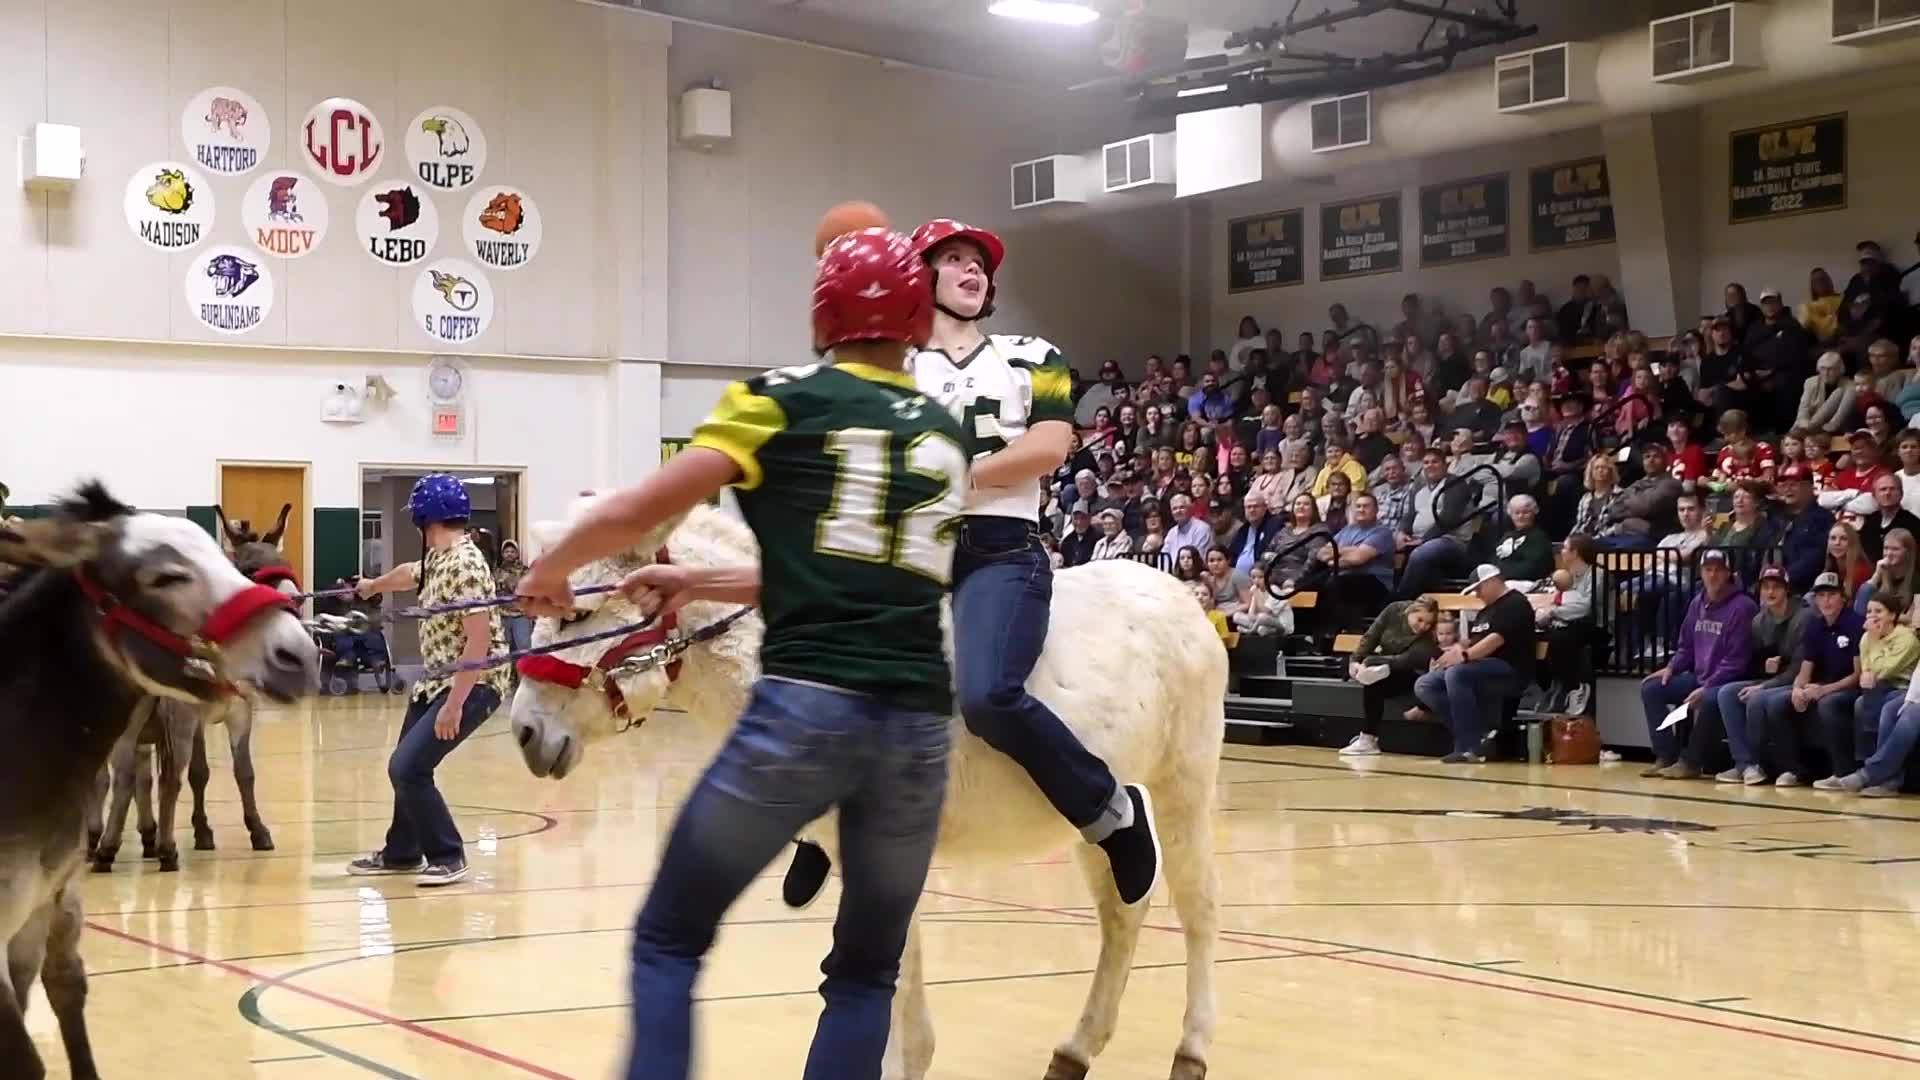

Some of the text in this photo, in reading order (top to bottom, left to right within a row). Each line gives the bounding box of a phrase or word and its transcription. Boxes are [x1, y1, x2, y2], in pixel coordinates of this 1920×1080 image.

[306, 109, 380, 175] LCL
[196, 144, 257, 172] HARTFORD
[419, 162, 474, 188] OLPE
[1769, 192, 1804, 211] 2022
[140, 220, 201, 248] MADISON
[257, 227, 315, 254] MDCV
[370, 236, 426, 264] LEBO
[476, 240, 529, 267] WAVERLY
[201, 303, 261, 330] BURLINGAME
[425, 314, 481, 341] S. COFFEY
[813, 426, 969, 582] 12
